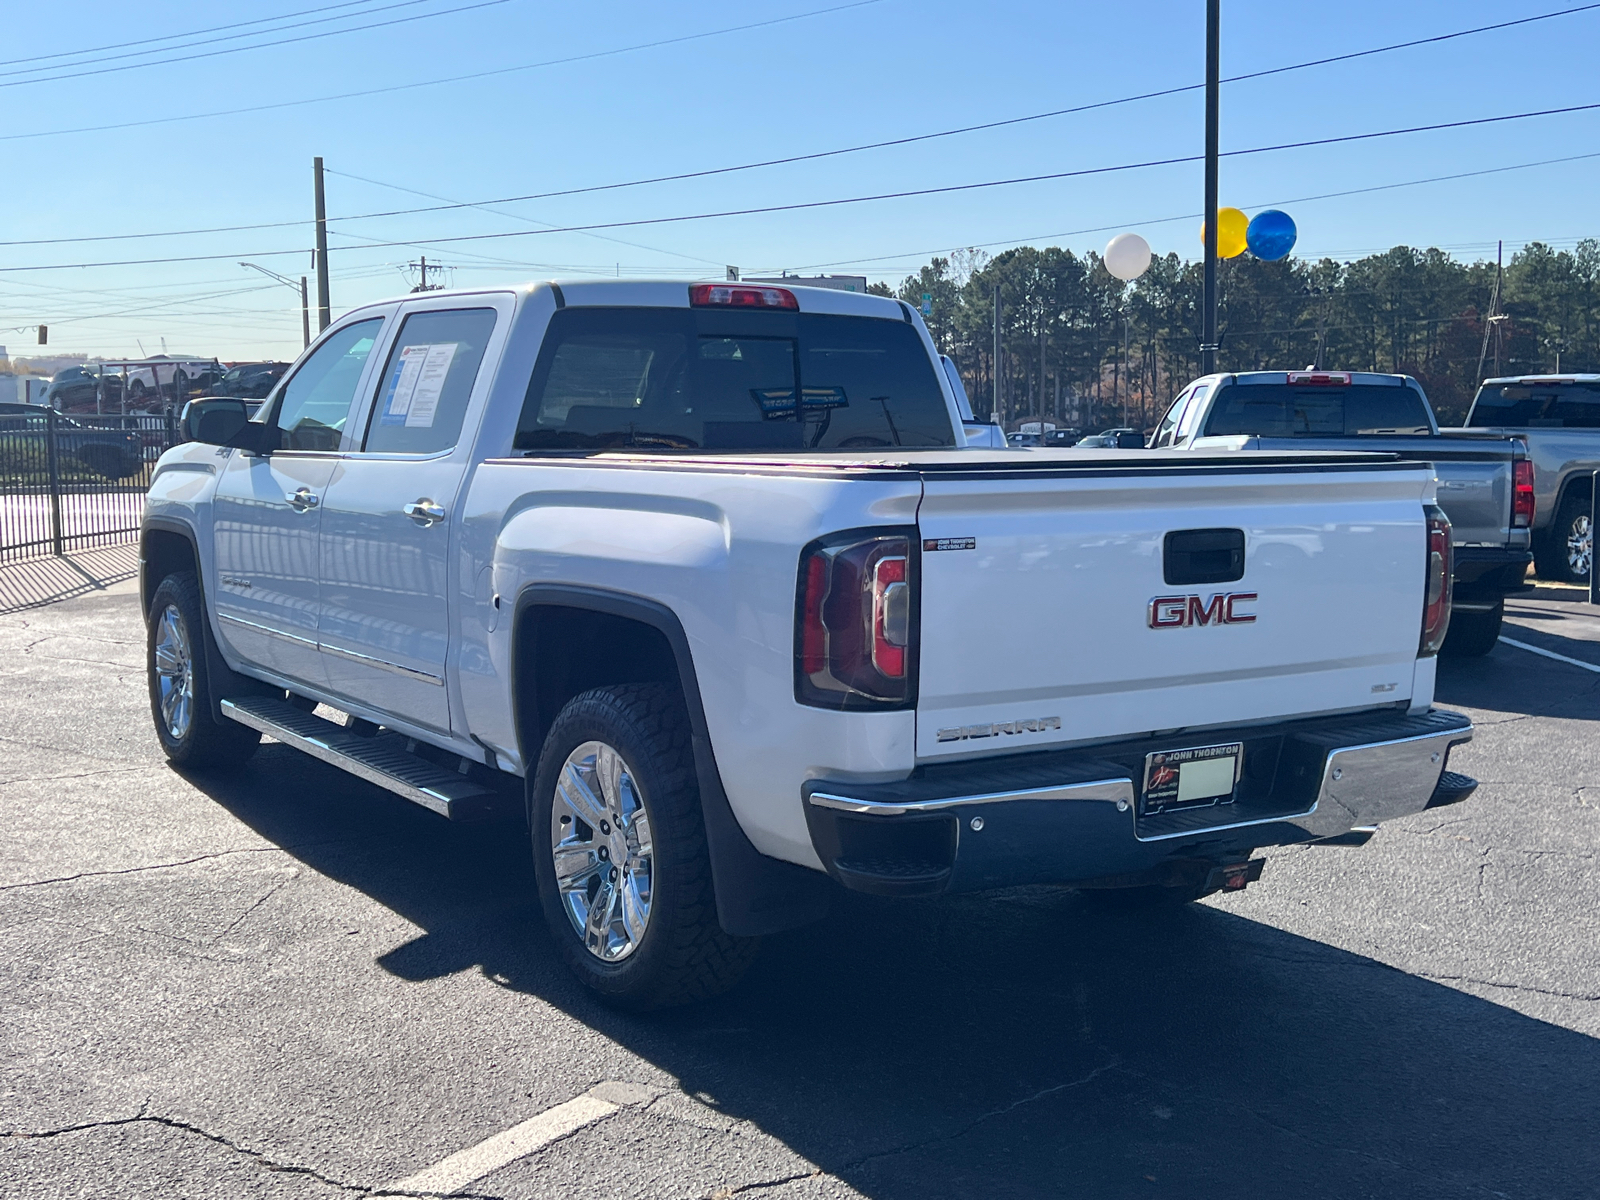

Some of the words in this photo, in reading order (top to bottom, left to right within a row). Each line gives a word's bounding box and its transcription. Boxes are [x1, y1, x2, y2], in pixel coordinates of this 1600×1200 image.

[1148, 591, 1258, 629] GMC
[936, 716, 1061, 742] SIERRA
[1169, 750, 1193, 761] JOHN
[1194, 745, 1239, 758] THORNTON
